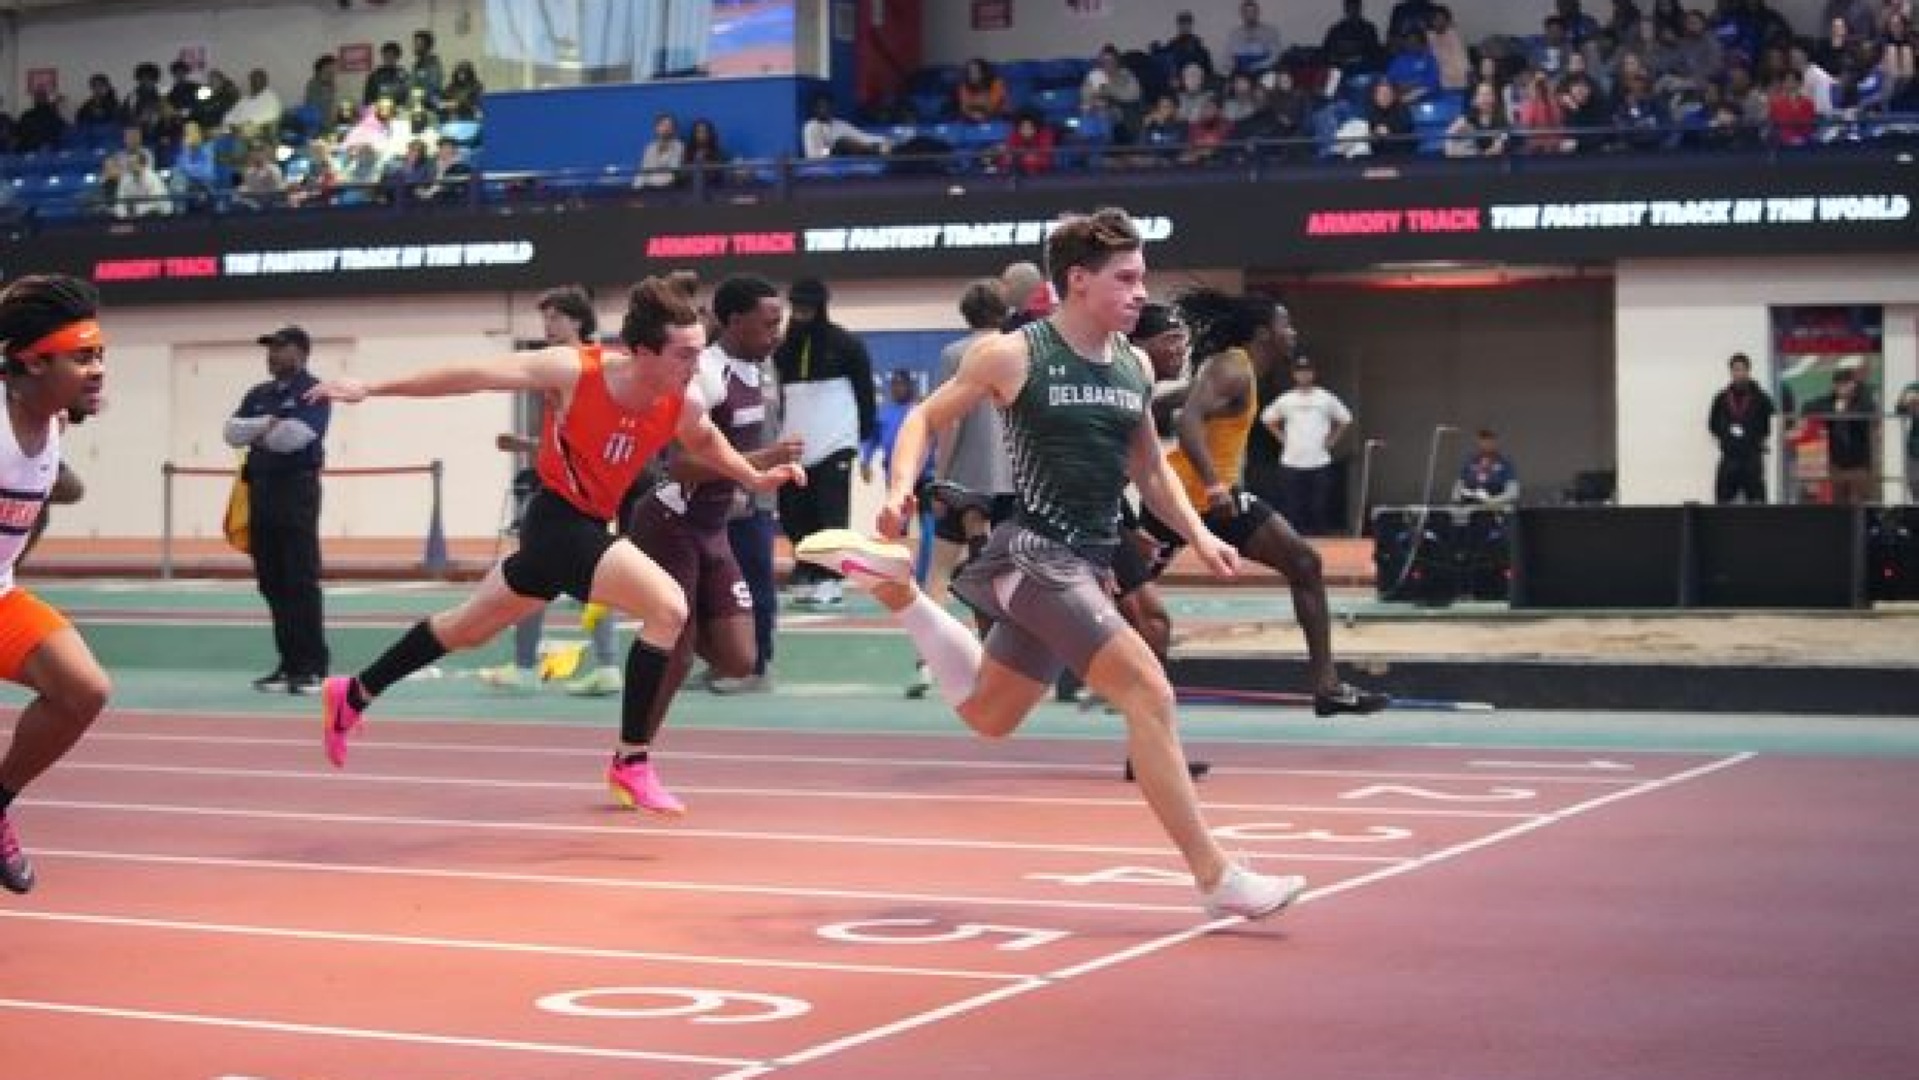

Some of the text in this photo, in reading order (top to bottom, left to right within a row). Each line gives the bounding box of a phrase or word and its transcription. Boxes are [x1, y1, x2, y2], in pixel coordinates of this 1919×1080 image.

[1307, 195, 1910, 234] ARMORY TRACK THE FASTEST TRACK IN THE WORLD
[731, 231, 796, 254] TRACK
[804, 229, 846, 252] THE
[943, 222, 1014, 247] TRACK
[1337, 783, 1536, 800] 2
[815, 918, 1072, 951] 5
